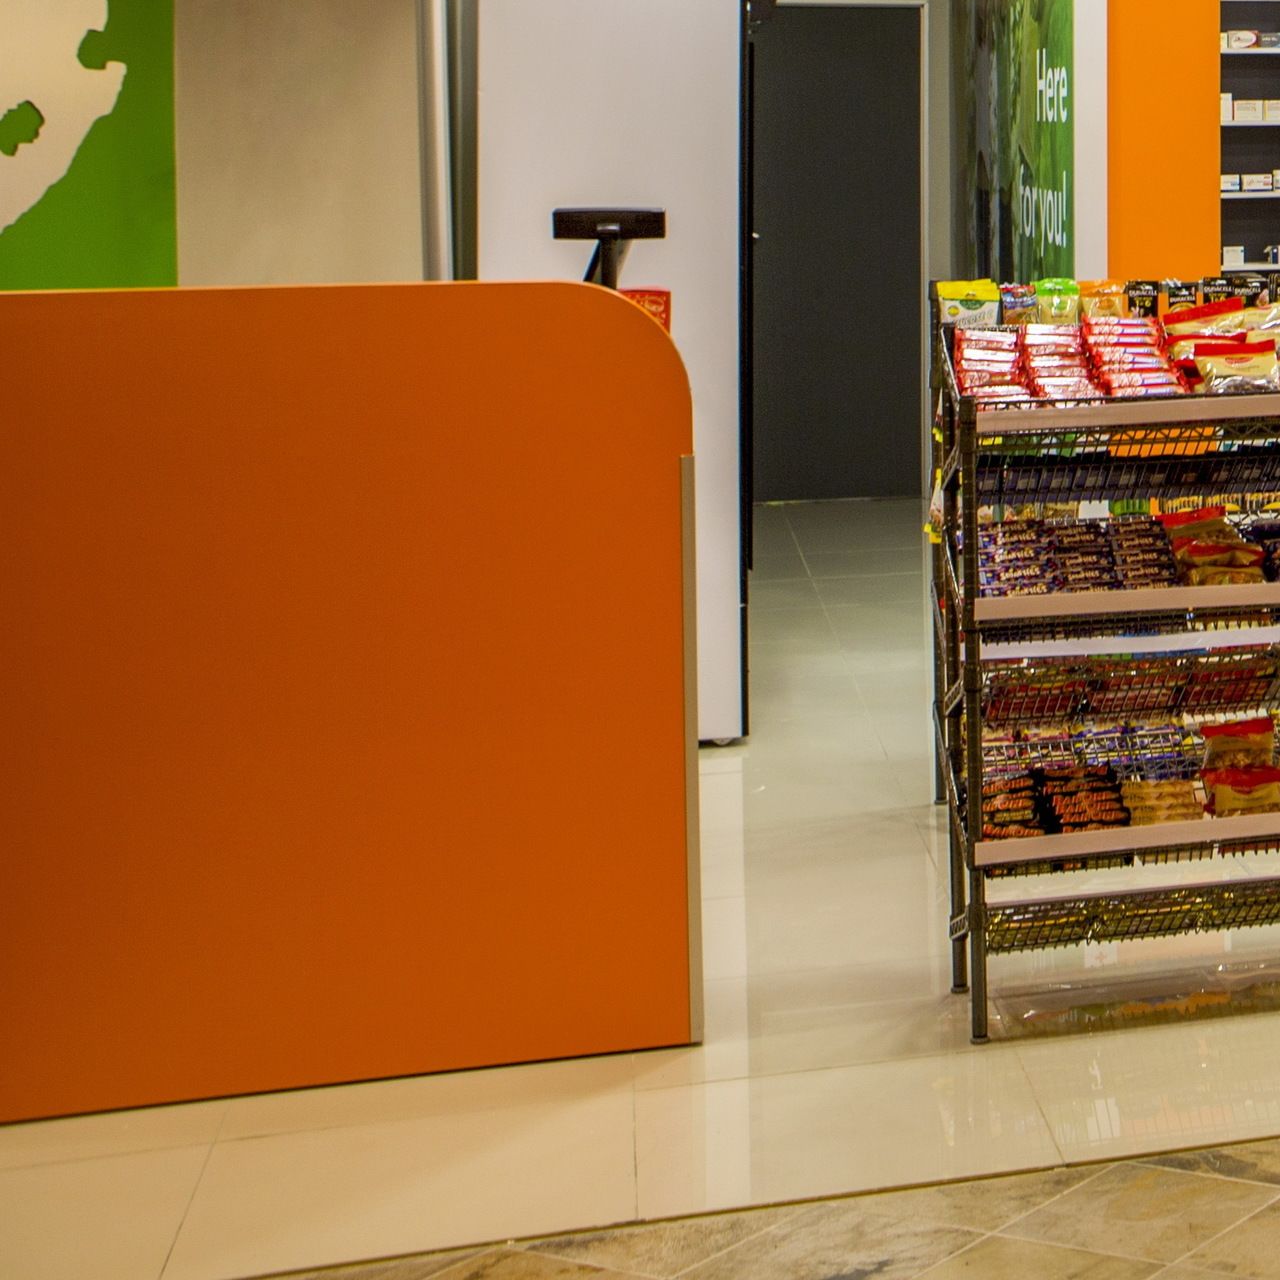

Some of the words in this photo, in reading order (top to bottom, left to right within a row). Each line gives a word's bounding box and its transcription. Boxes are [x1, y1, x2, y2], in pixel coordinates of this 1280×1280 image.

[1036, 48, 1068, 123] Here
[1019, 163, 1037, 238] for
[1039, 170, 1067, 257] you!
